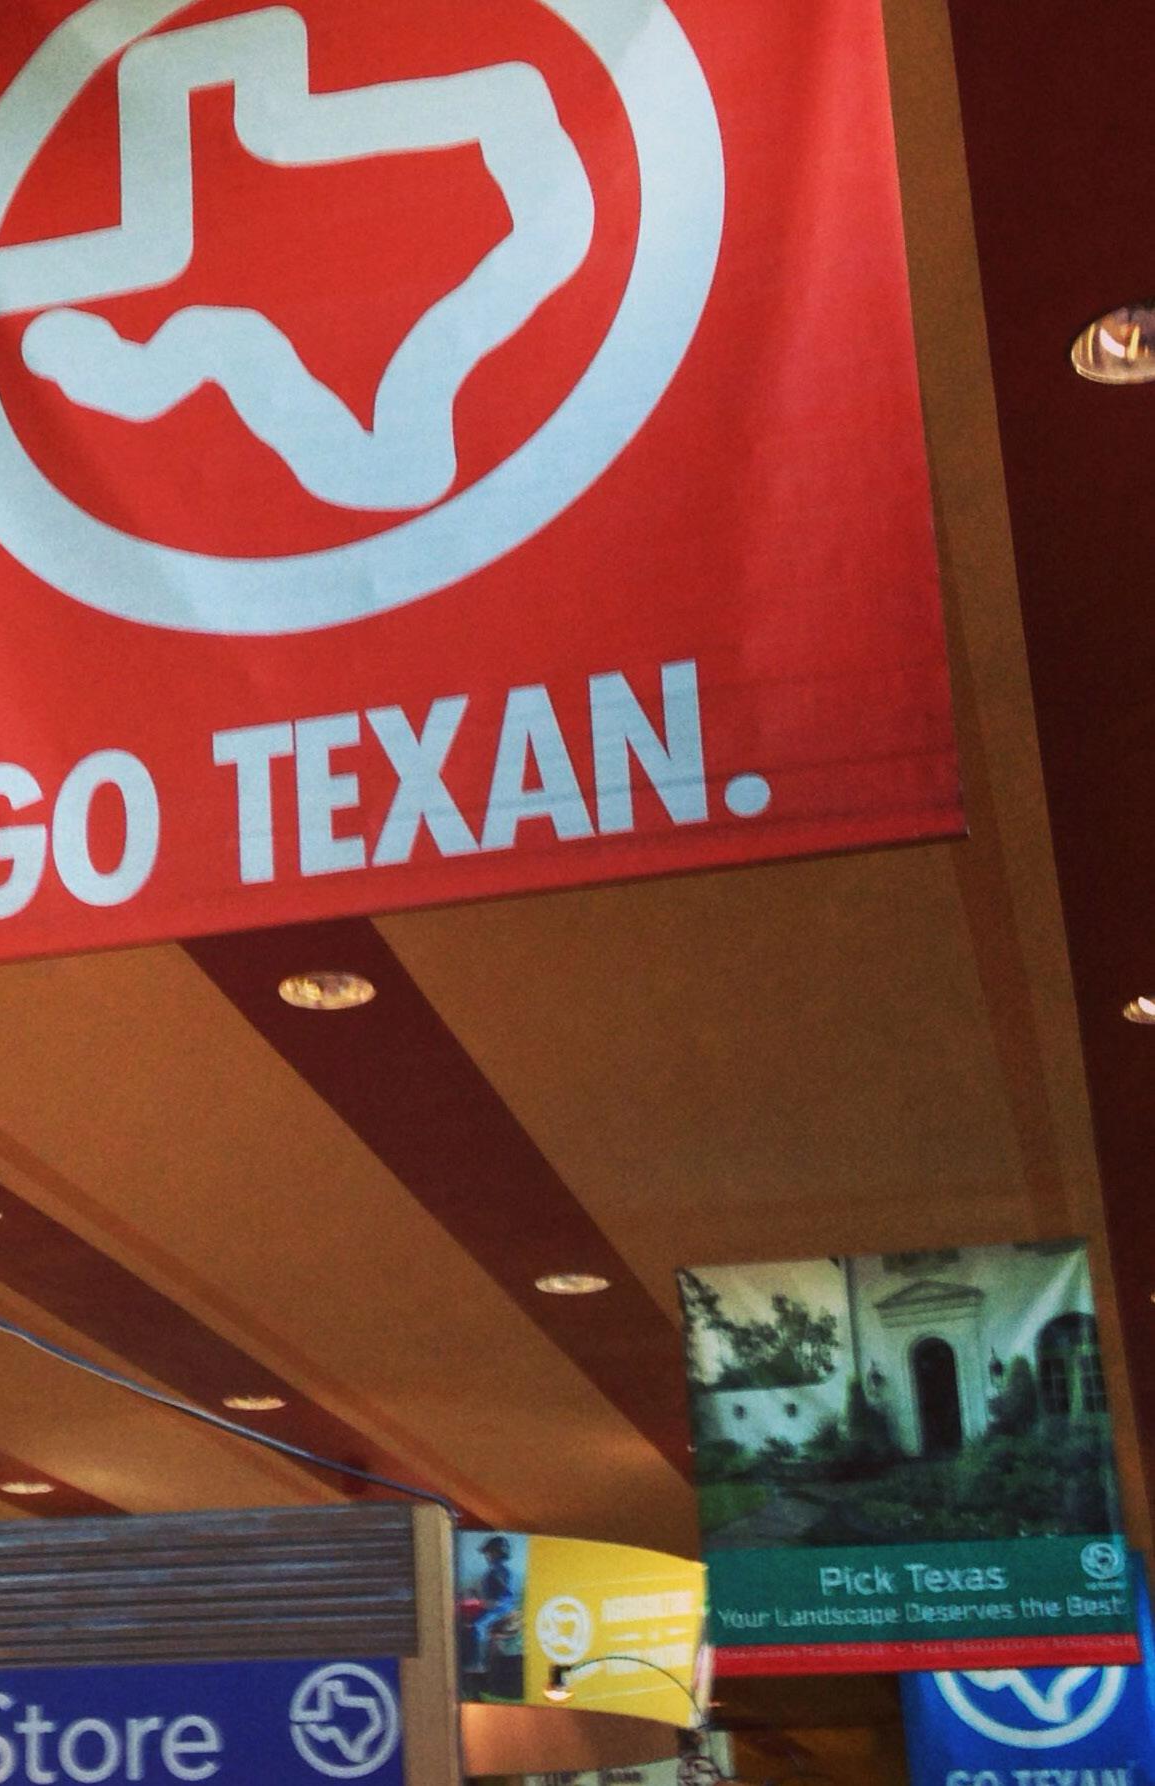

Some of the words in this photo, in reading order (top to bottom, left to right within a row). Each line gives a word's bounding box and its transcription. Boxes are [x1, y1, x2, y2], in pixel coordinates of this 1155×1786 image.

[212, 660, 771, 884] TEXAN.
[819, 1565, 896, 1596] Pick
[903, 1562, 1010, 1593] Texas
[717, 1608, 771, 1630] Your
[775, 1605, 901, 1628] Landscape
[905, 1600, 1016, 1623] Deserves
[1019, 1595, 1061, 1619] the
